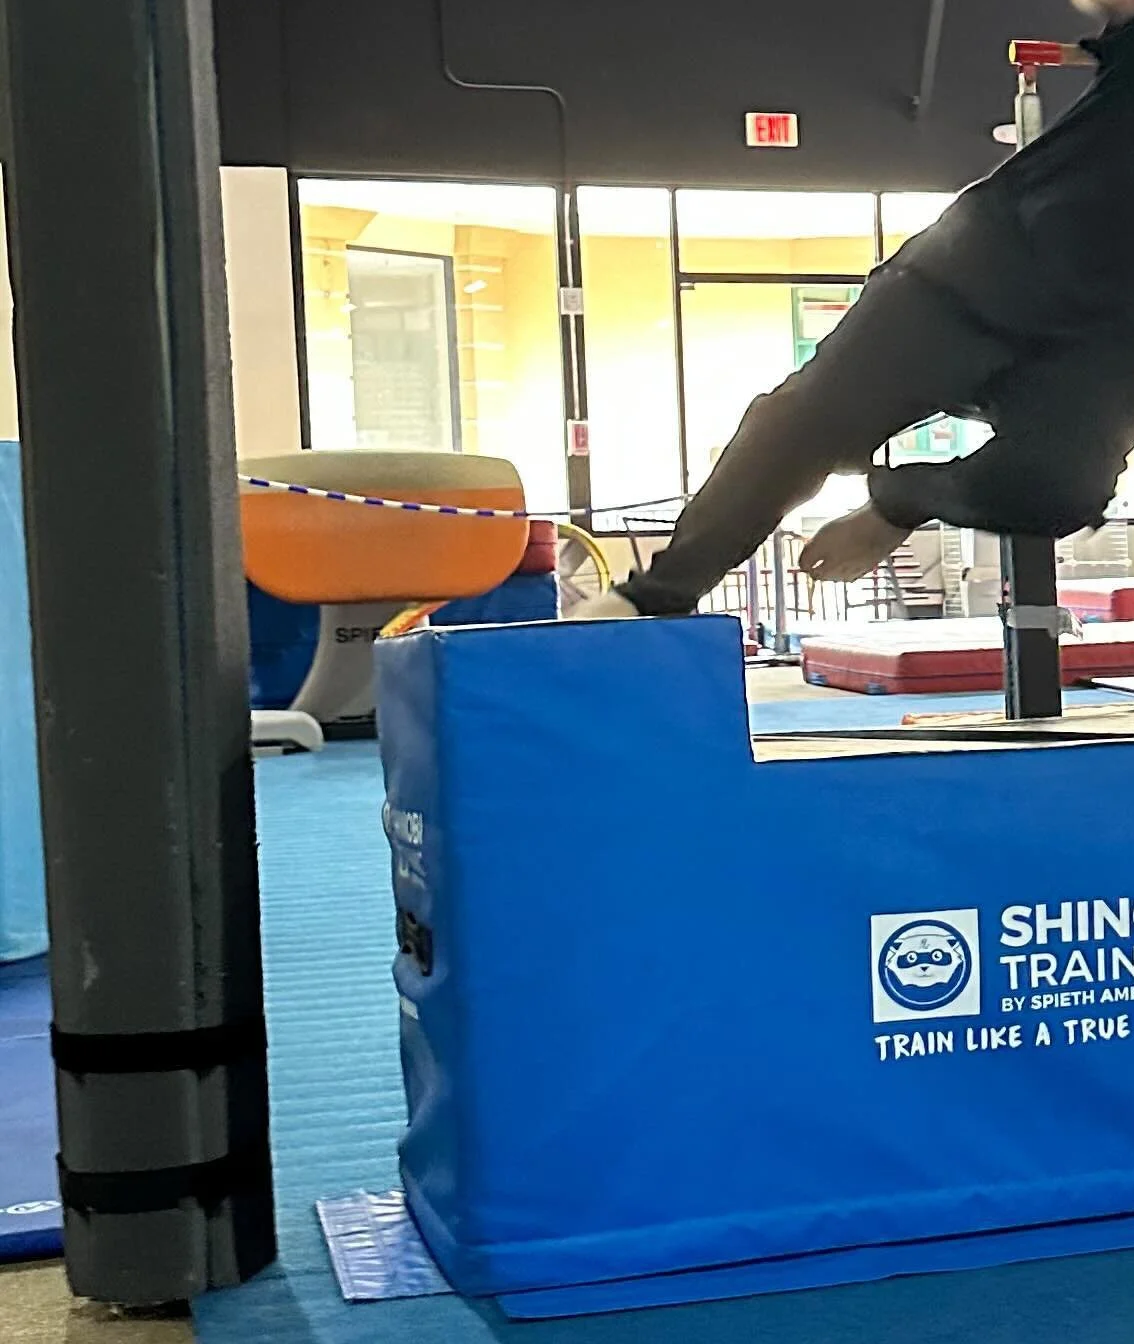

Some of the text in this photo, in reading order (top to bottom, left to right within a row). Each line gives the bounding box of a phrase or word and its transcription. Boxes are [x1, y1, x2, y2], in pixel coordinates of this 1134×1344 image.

[755, 114, 790, 143] EXIT
[1001, 996, 1024, 1012] BY
[1031, 987, 1095, 1010] SPIETH
[875, 1030, 954, 1061] TRAIN
[966, 1024, 1022, 1051] LIKE
[1035, 1021, 1051, 1047] A
[1064, 1014, 1129, 1043] TRUE
